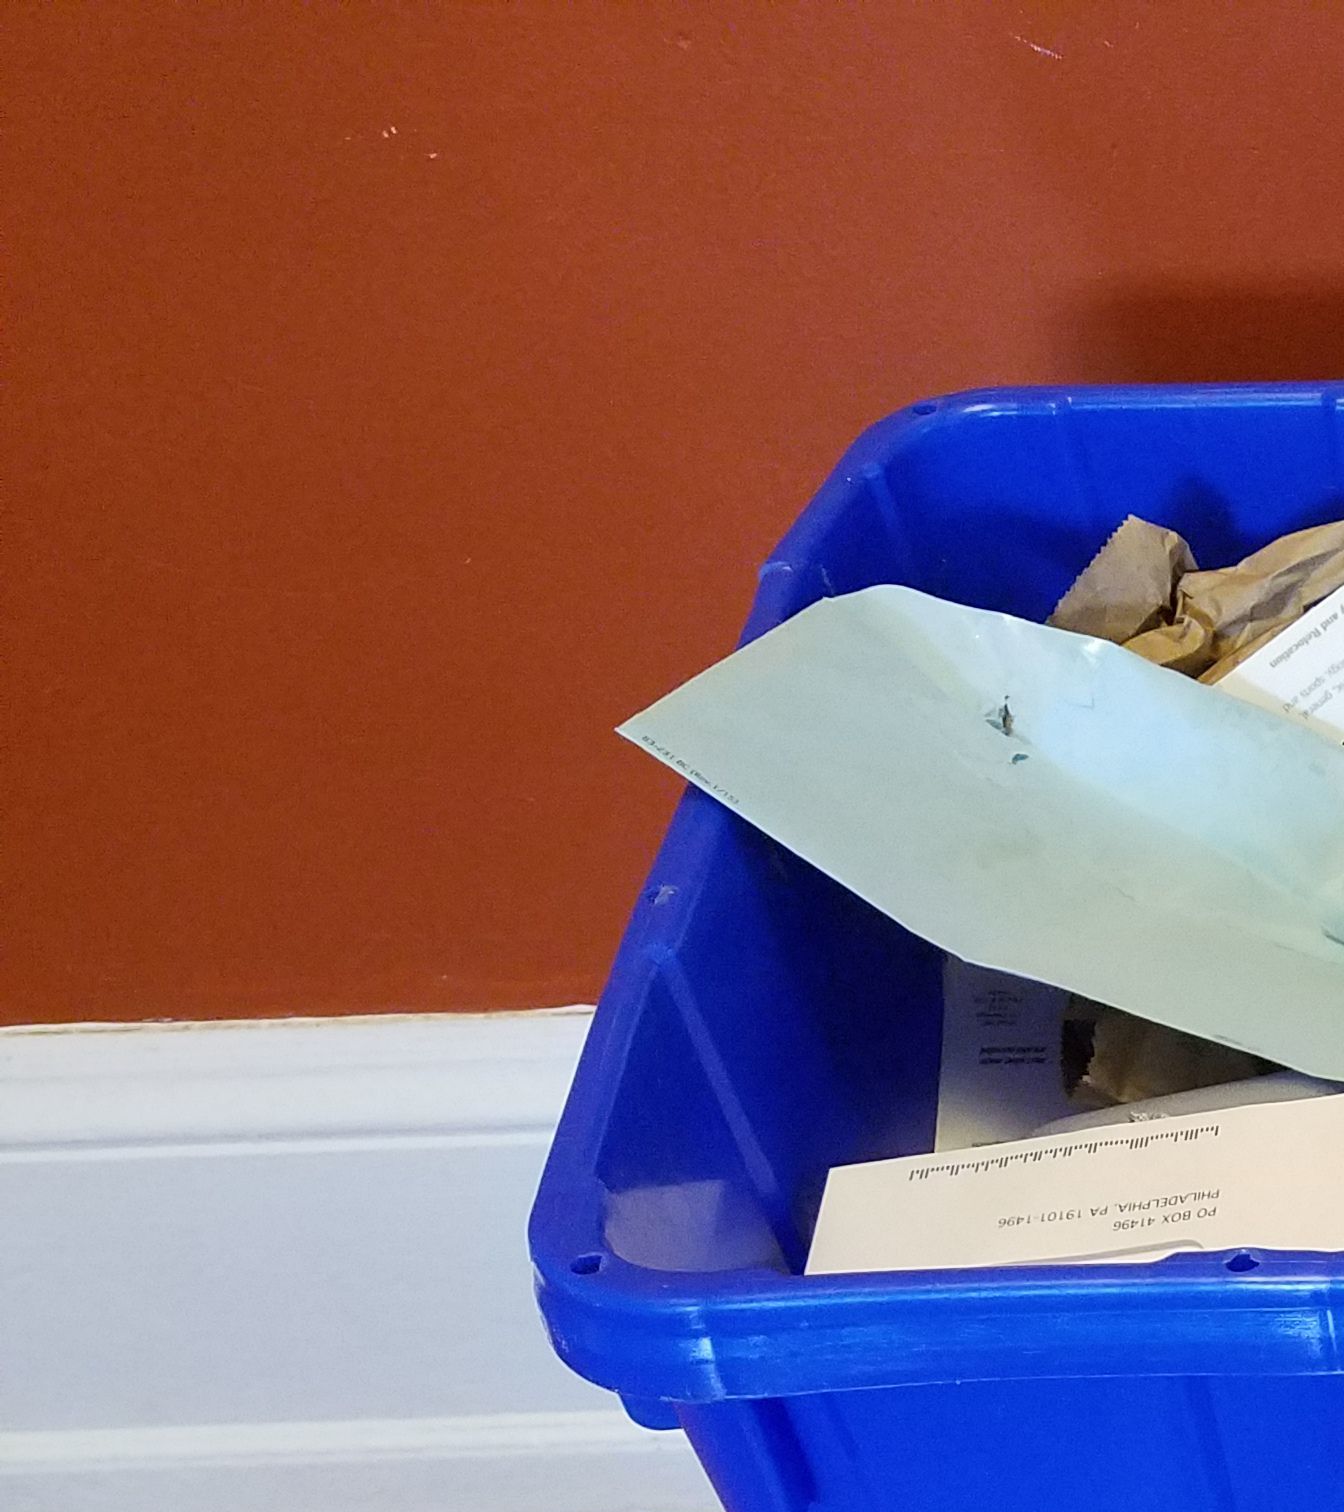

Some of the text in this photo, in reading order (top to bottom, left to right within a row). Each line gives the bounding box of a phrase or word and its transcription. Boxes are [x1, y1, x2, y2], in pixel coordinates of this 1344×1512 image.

[996, 1208, 1082, 1228] 19101-1496
[1089, 1205, 1108, 1216] PA
[1111, 1206, 1216, 1230] PO BOX 41496
